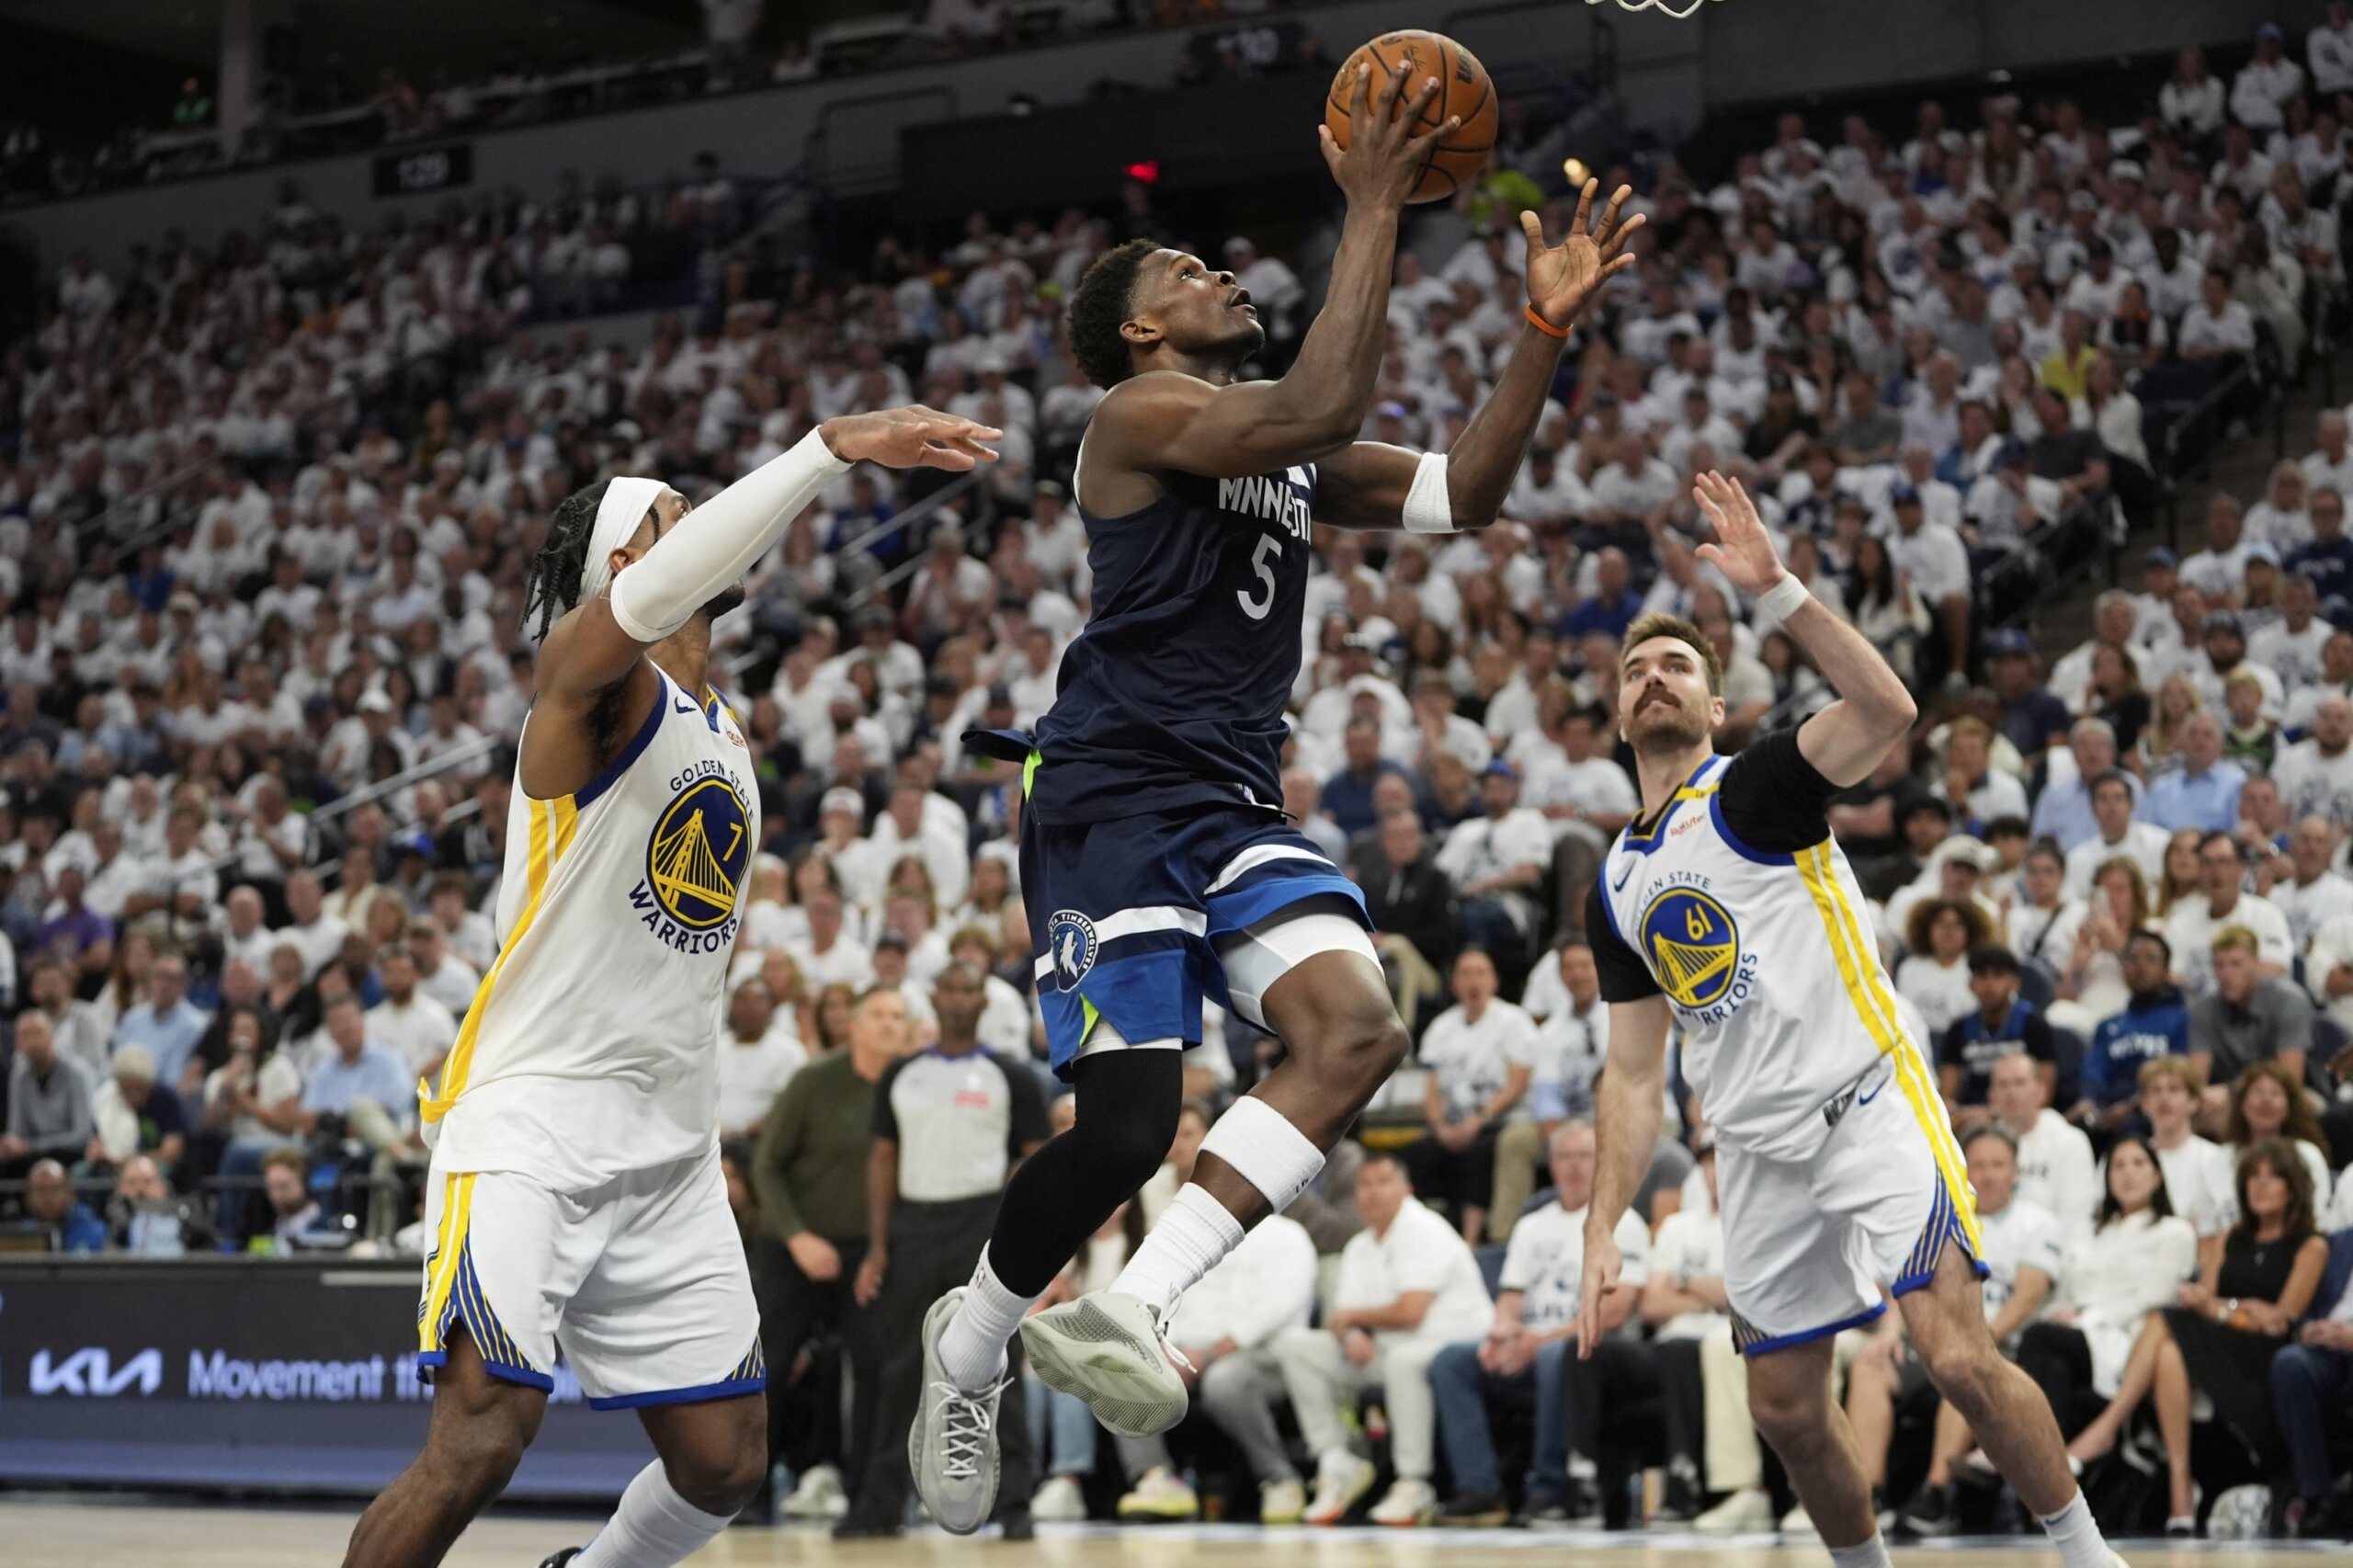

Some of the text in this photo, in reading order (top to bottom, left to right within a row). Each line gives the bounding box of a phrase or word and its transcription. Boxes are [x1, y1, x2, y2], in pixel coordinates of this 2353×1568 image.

[1237, 532, 1282, 620] 5
[670, 759, 754, 822] GOLDEN STATE
[722, 823, 743, 862] 7
[1669, 870, 1711, 889] STATE
[629, 879, 738, 955] WARRIORS
[1061, 914, 1095, 970] TIMBERWOLVES
[1686, 903, 1713, 941] 61
[1677, 953, 1757, 1026] RRIORS
[188, 1347, 385, 1401] Movement
